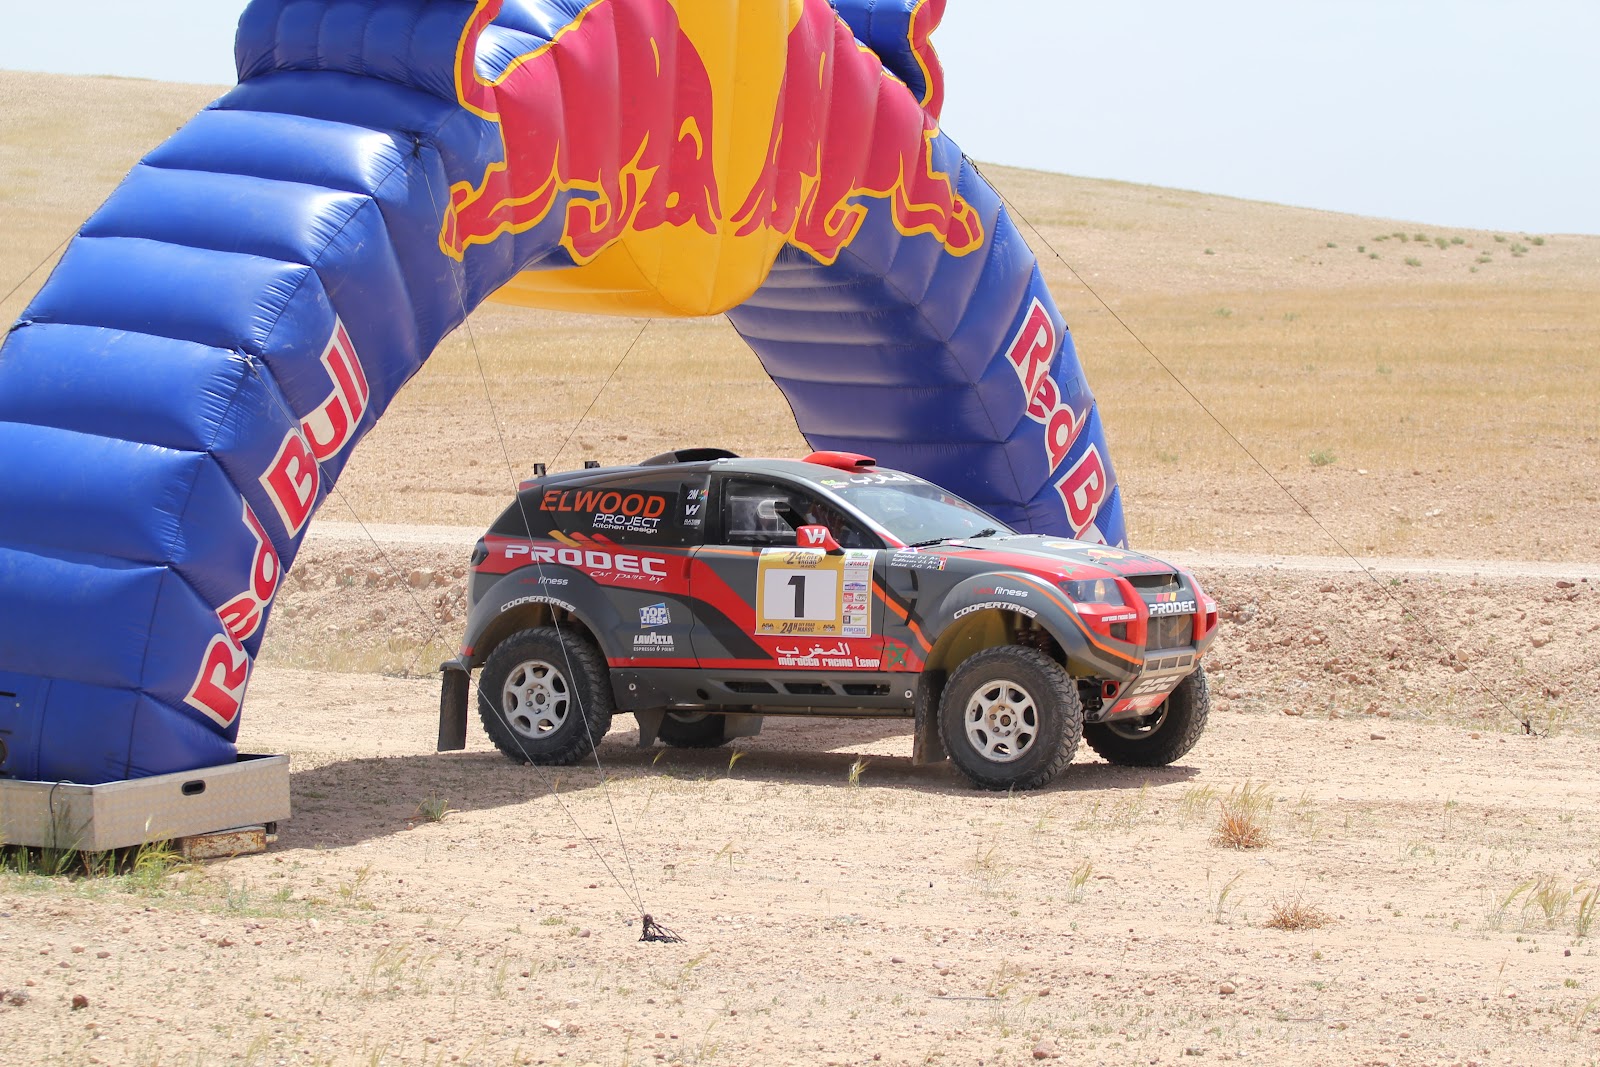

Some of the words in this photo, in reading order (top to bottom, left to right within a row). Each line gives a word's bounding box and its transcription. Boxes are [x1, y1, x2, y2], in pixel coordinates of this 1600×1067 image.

[1005, 296, 1086, 477] Red
[540, 490, 666, 517] ELWOOD
[183, 494, 280, 729] Red
[259, 314, 369, 539] Bull
[592, 522, 625, 531] Kitchen
[626, 525, 658, 534] Design
[594, 513, 661, 528] PROJECT
[805, 529, 826, 544] VH
[505, 545, 667, 577] PRODEC
[649, 575, 664, 584] by
[787, 575, 806, 618] 1
[640, 606, 667, 618] TOP
[1149, 600, 1196, 616] PRODEC
[640, 615, 669, 625] class
[633, 632, 674, 645] LAVAZZA
[854, 656, 880, 668] team
